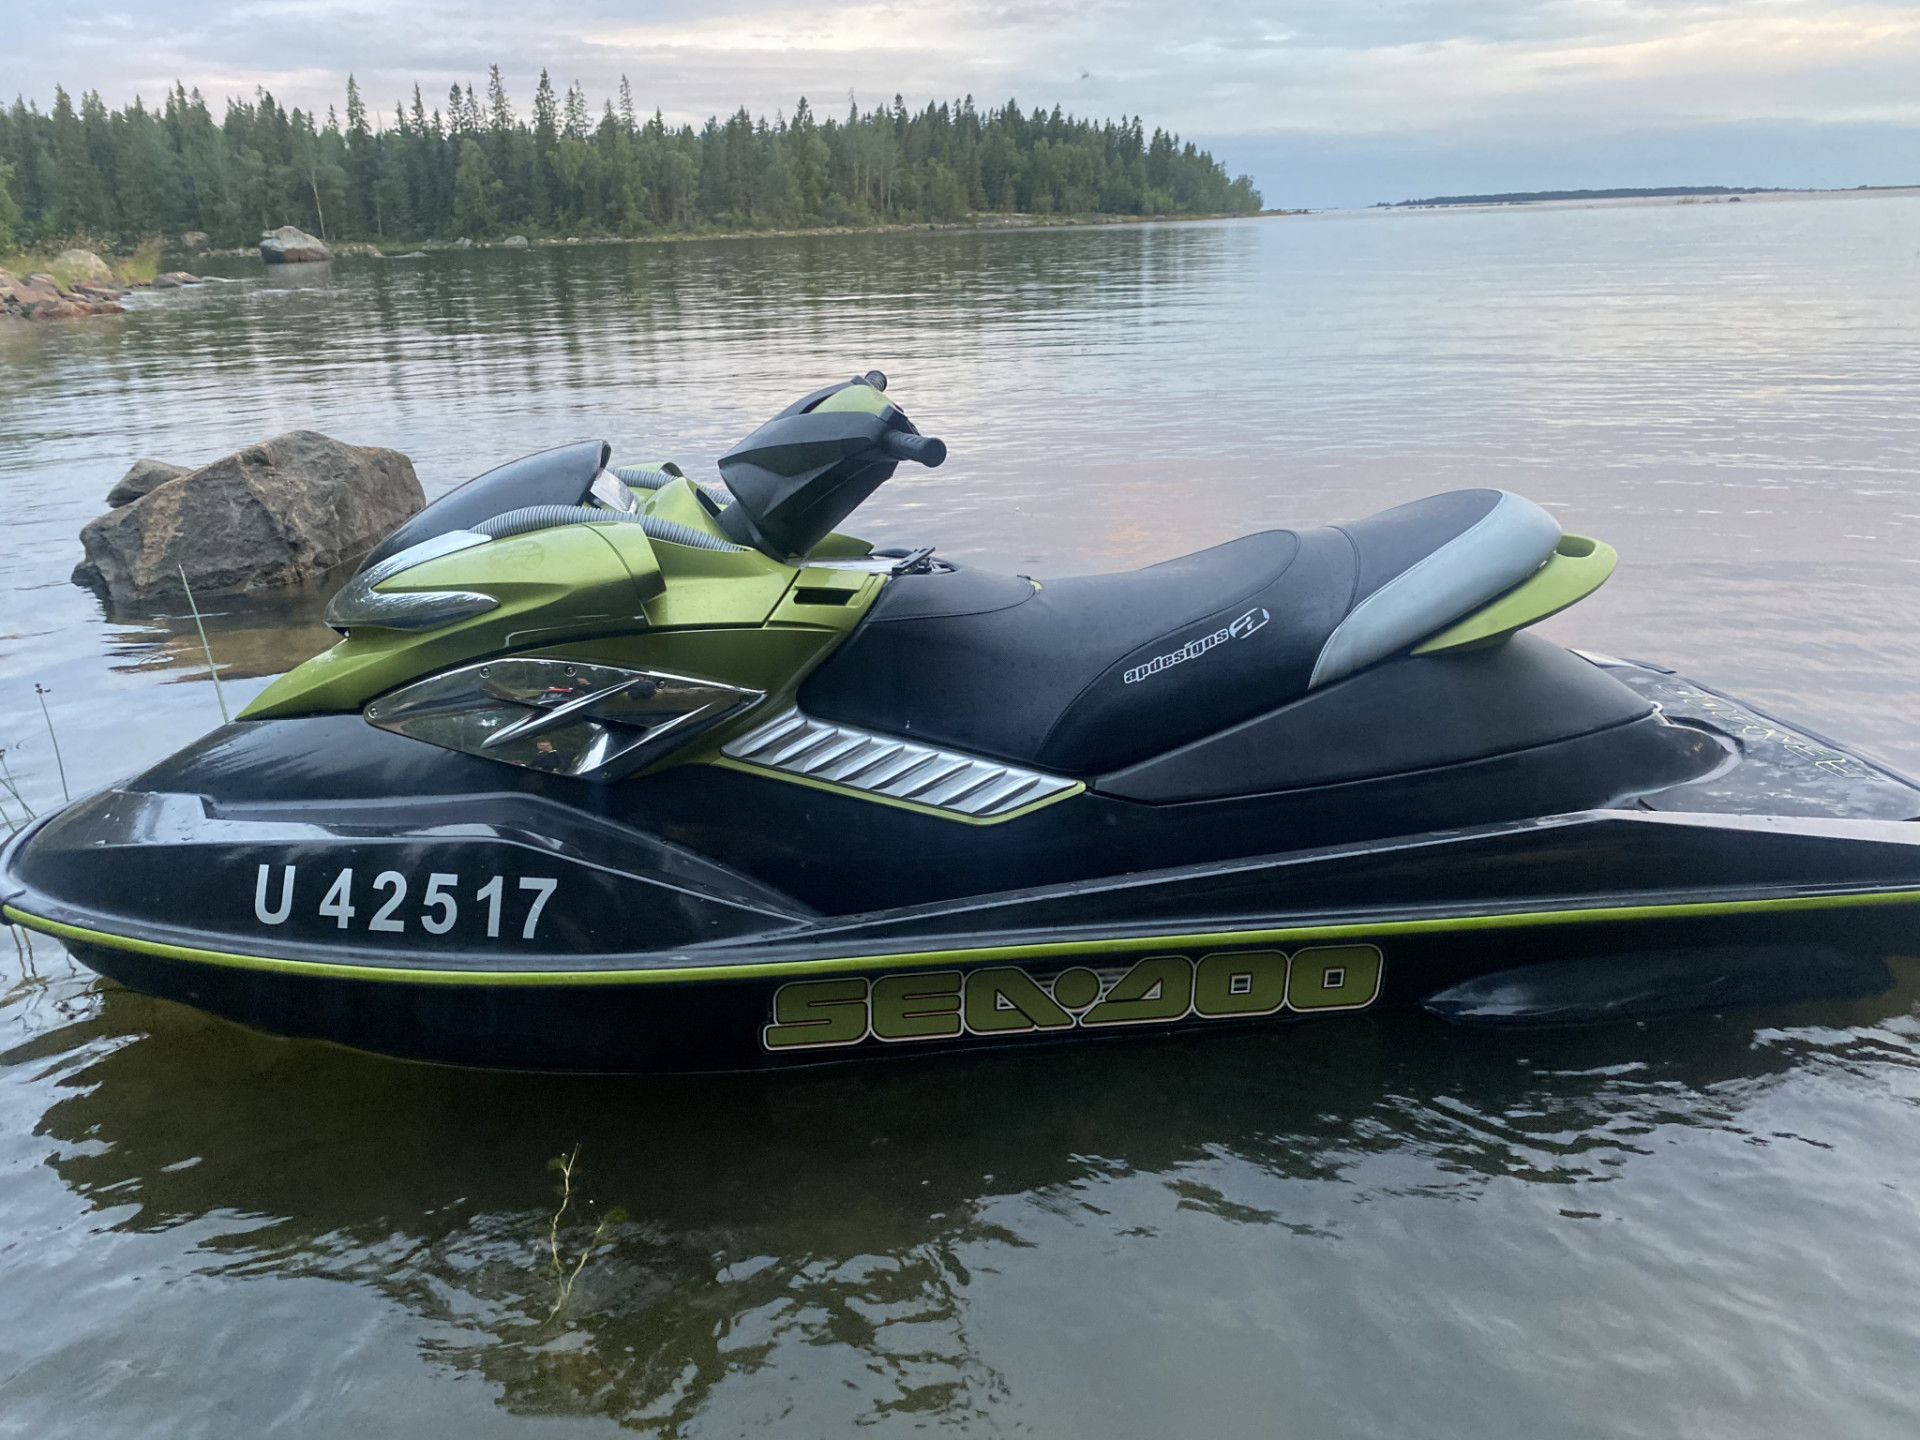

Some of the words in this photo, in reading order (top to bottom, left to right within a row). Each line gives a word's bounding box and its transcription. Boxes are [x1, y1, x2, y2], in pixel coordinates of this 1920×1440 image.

[1124, 628, 1229, 684] apdesigns
[254, 864, 296, 925] U
[319, 868, 558, 939] 42517
